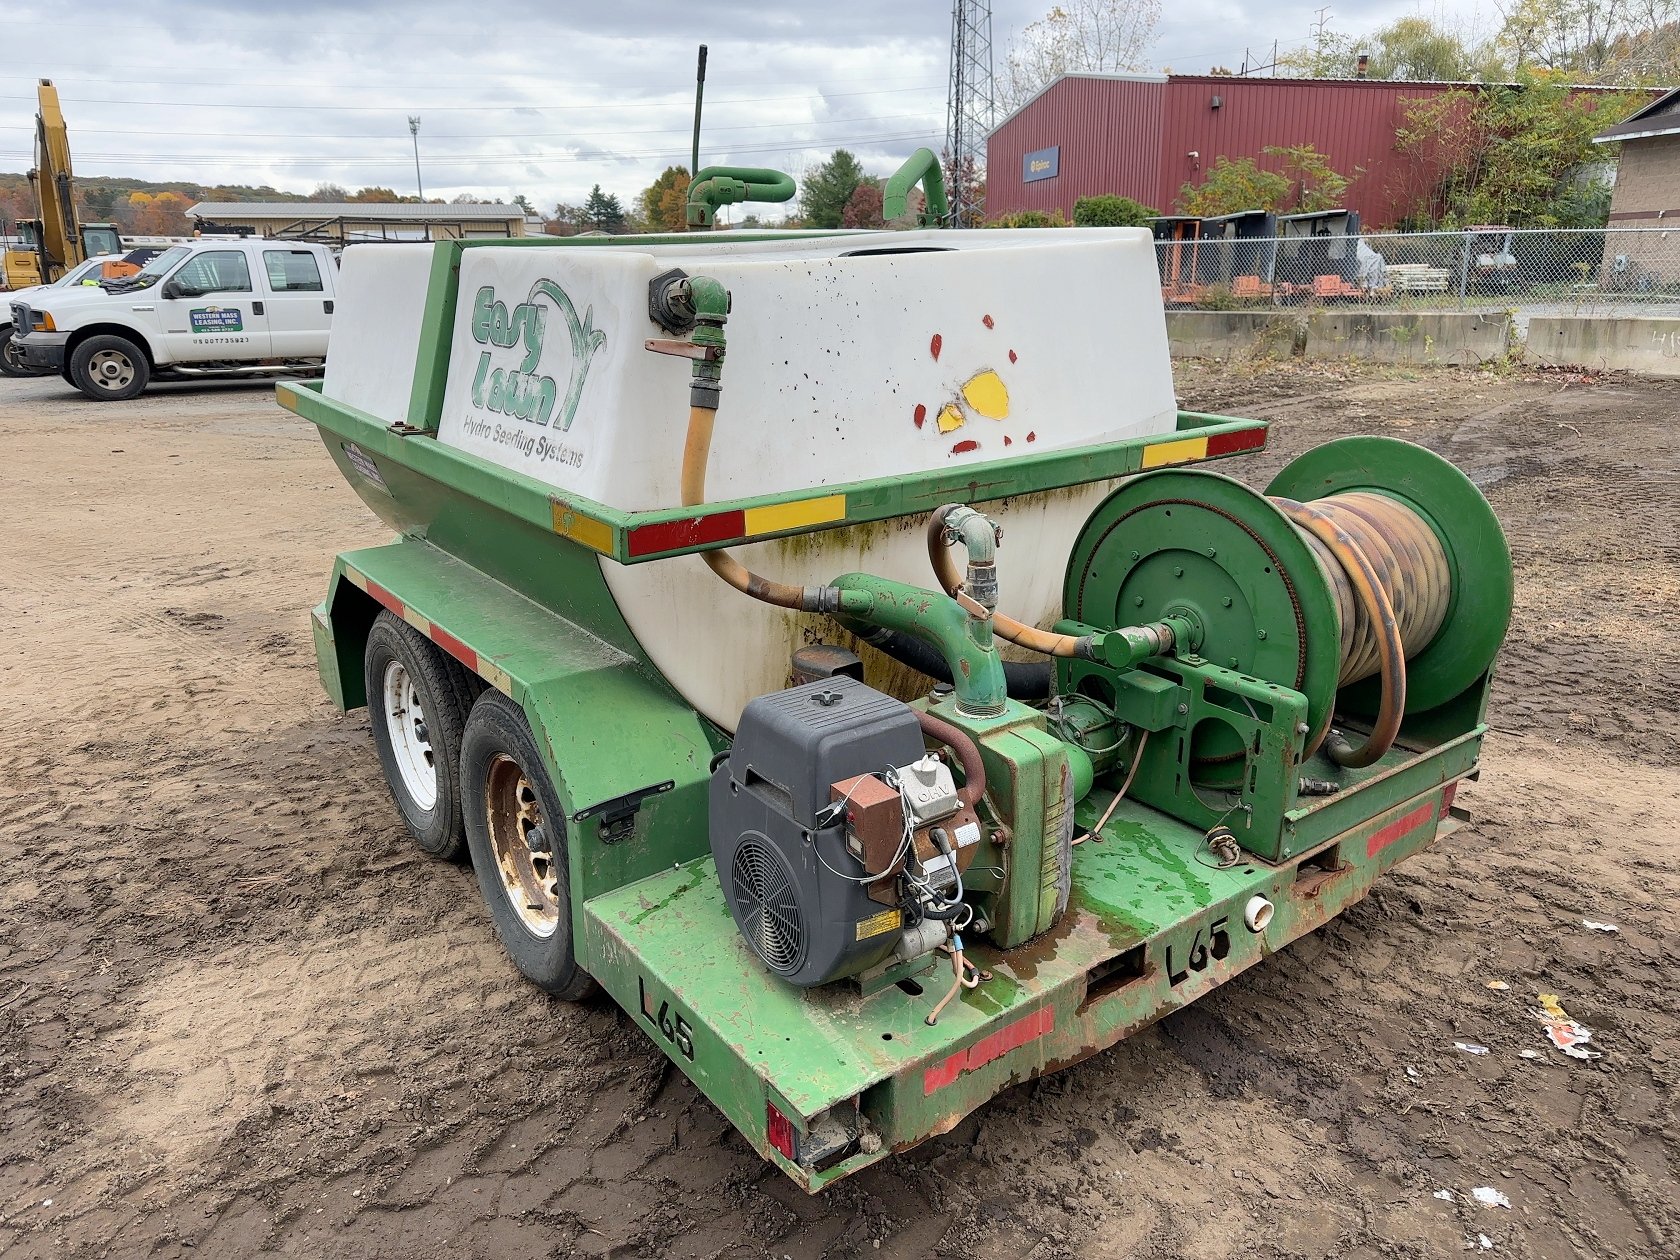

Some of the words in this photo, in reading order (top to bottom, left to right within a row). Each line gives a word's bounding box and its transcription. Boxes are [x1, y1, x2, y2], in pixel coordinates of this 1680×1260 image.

[472, 286, 548, 374] Easy
[463, 415, 492, 439] Hydro
[492, 423, 535, 457] Seeding
[536, 435, 584, 468] Systems
[918, 783, 950, 803] OHV
[1165, 915, 1231, 987] L65
[638, 975, 695, 1063] L65
